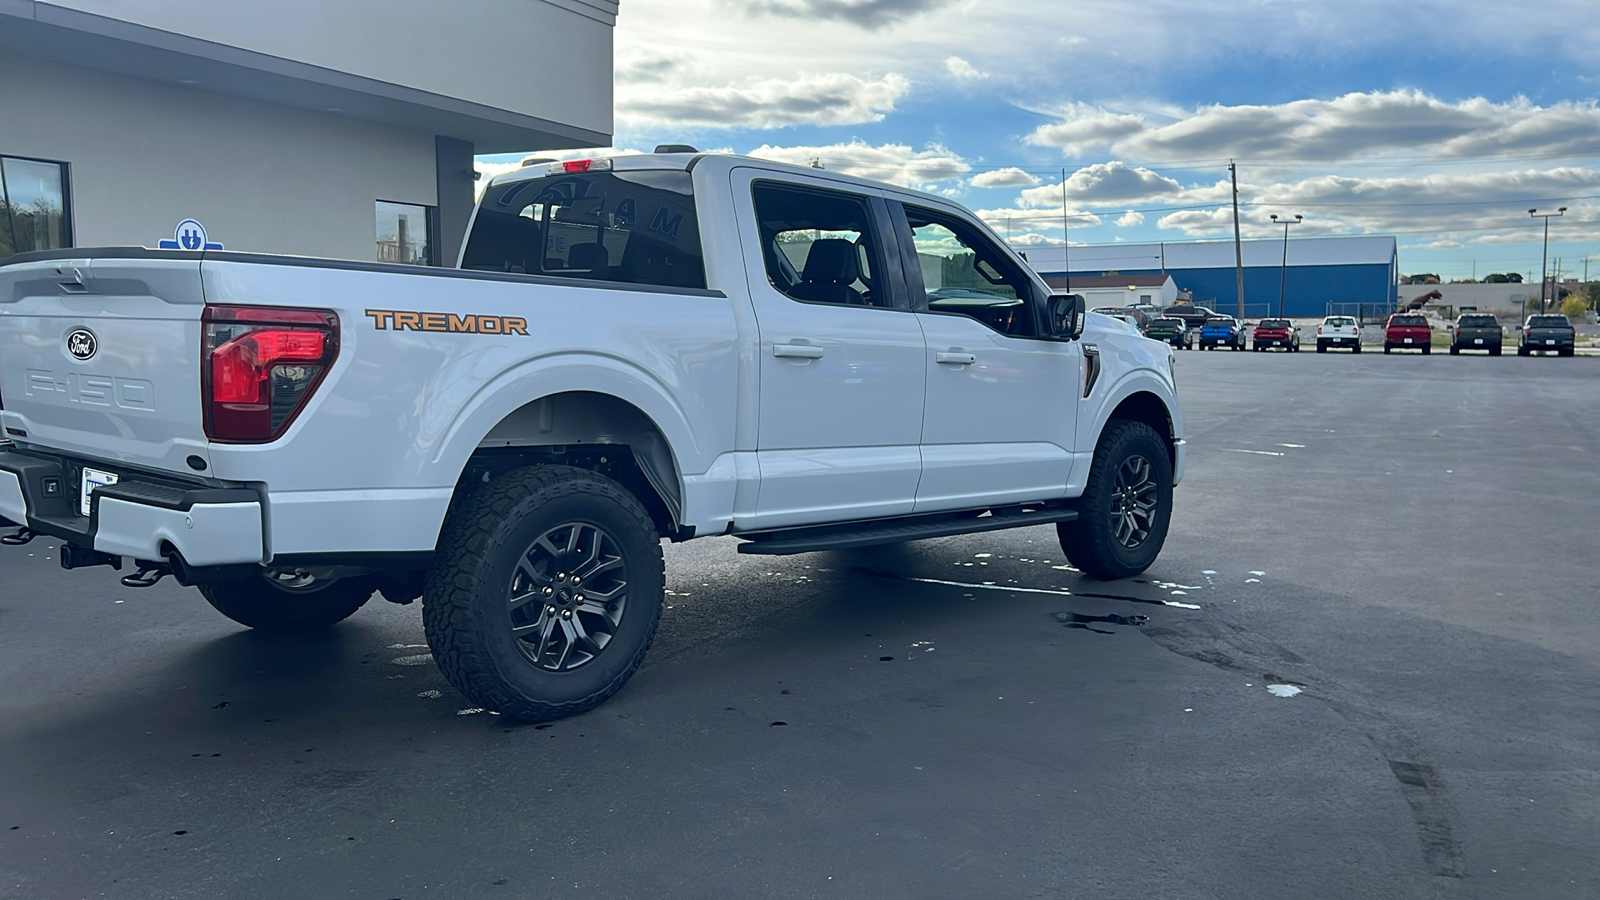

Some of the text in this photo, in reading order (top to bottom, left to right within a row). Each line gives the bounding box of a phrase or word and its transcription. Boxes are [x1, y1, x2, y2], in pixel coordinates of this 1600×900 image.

[364, 309, 531, 336] TREMOR
[70, 332, 92, 356] Ford
[25, 368, 156, 412] F-150
